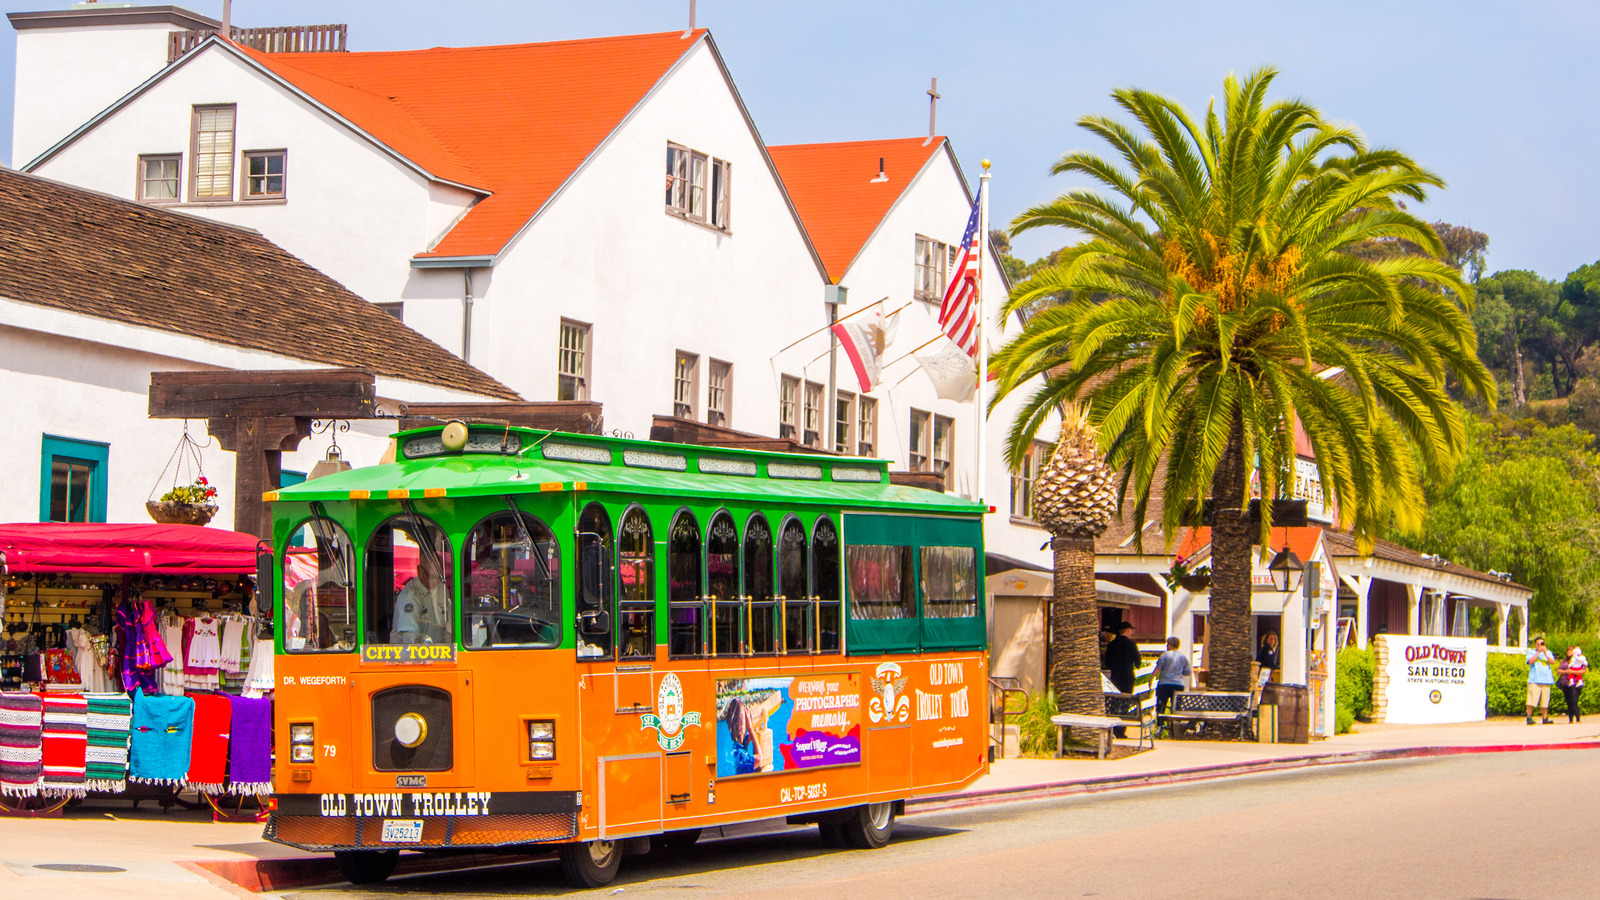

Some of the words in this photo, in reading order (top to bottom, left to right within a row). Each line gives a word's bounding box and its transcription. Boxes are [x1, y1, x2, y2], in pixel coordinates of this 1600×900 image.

[366, 645, 403, 660] CITY
[408, 645, 452, 659] TOUR
[1405, 645, 1431, 662] OLD
[1431, 643, 1467, 664] TOWN
[283, 676, 297, 686] DR.
[300, 676, 347, 686] WEGEFORTH
[929, 663, 944, 686] OLD
[944, 662, 964, 685] TOWN
[1408, 666, 1428, 677] SAN
[1432, 667, 1466, 678] DIEGO
[796, 694, 860, 712] PHOTOGRAPHIC
[915, 688, 943, 721] TROLLEY
[949, 685, 969, 719] TOURS
[643, 716, 655, 726] SEE
[670, 732, 684, 749] BEST
[684, 713, 700, 726] FIRST
[323, 745, 337, 758] 79
[321, 793, 347, 817] OLD
[353, 793, 403, 817] TOWN
[412, 792, 491, 816] TROLLEY
[384, 827, 420, 839] 3V25213
